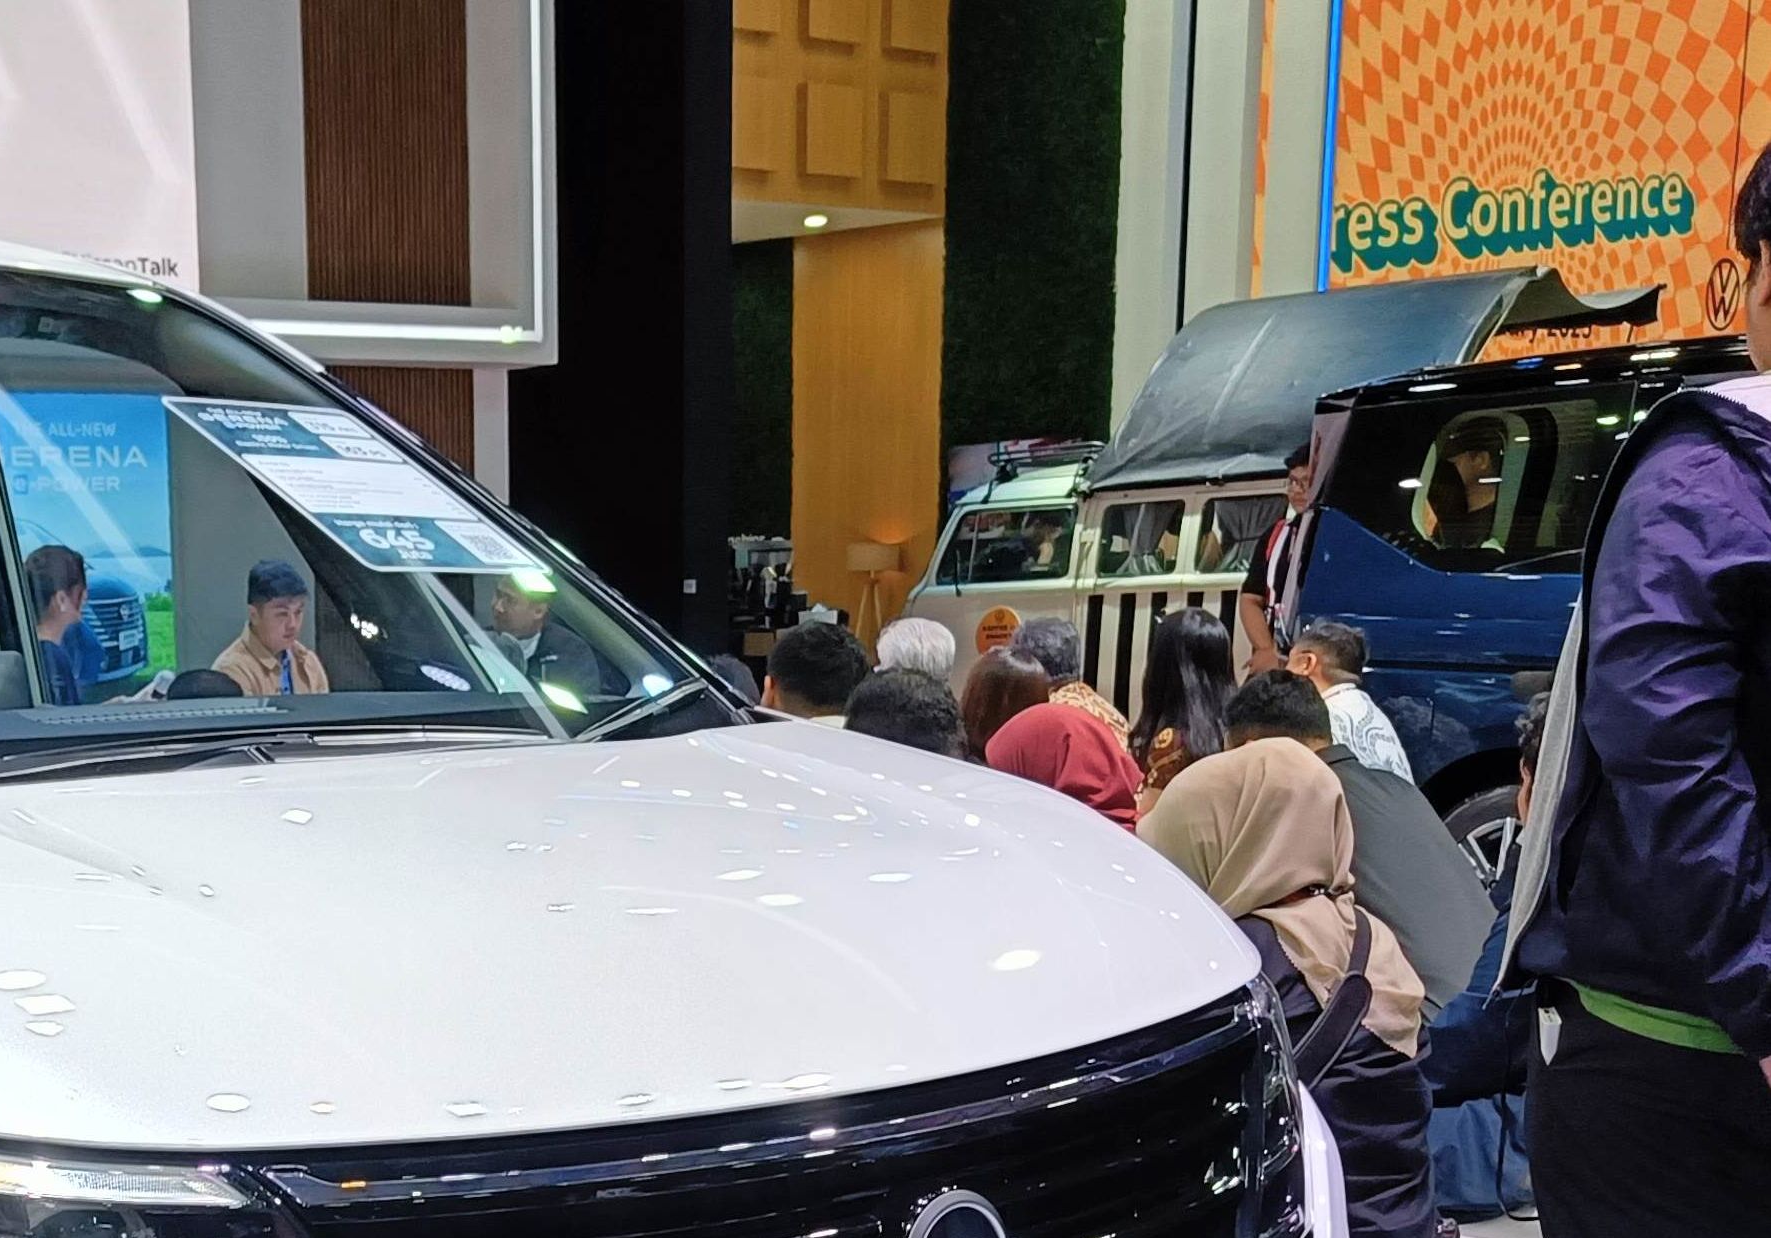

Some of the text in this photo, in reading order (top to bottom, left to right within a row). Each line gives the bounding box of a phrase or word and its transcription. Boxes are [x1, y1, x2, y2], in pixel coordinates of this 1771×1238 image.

[1441, 167, 1688, 248] Conference
[48, 422, 117, 438] ALL-NEW
[10, 445, 148, 468] ERENA
[359, 527, 435, 551] 645
